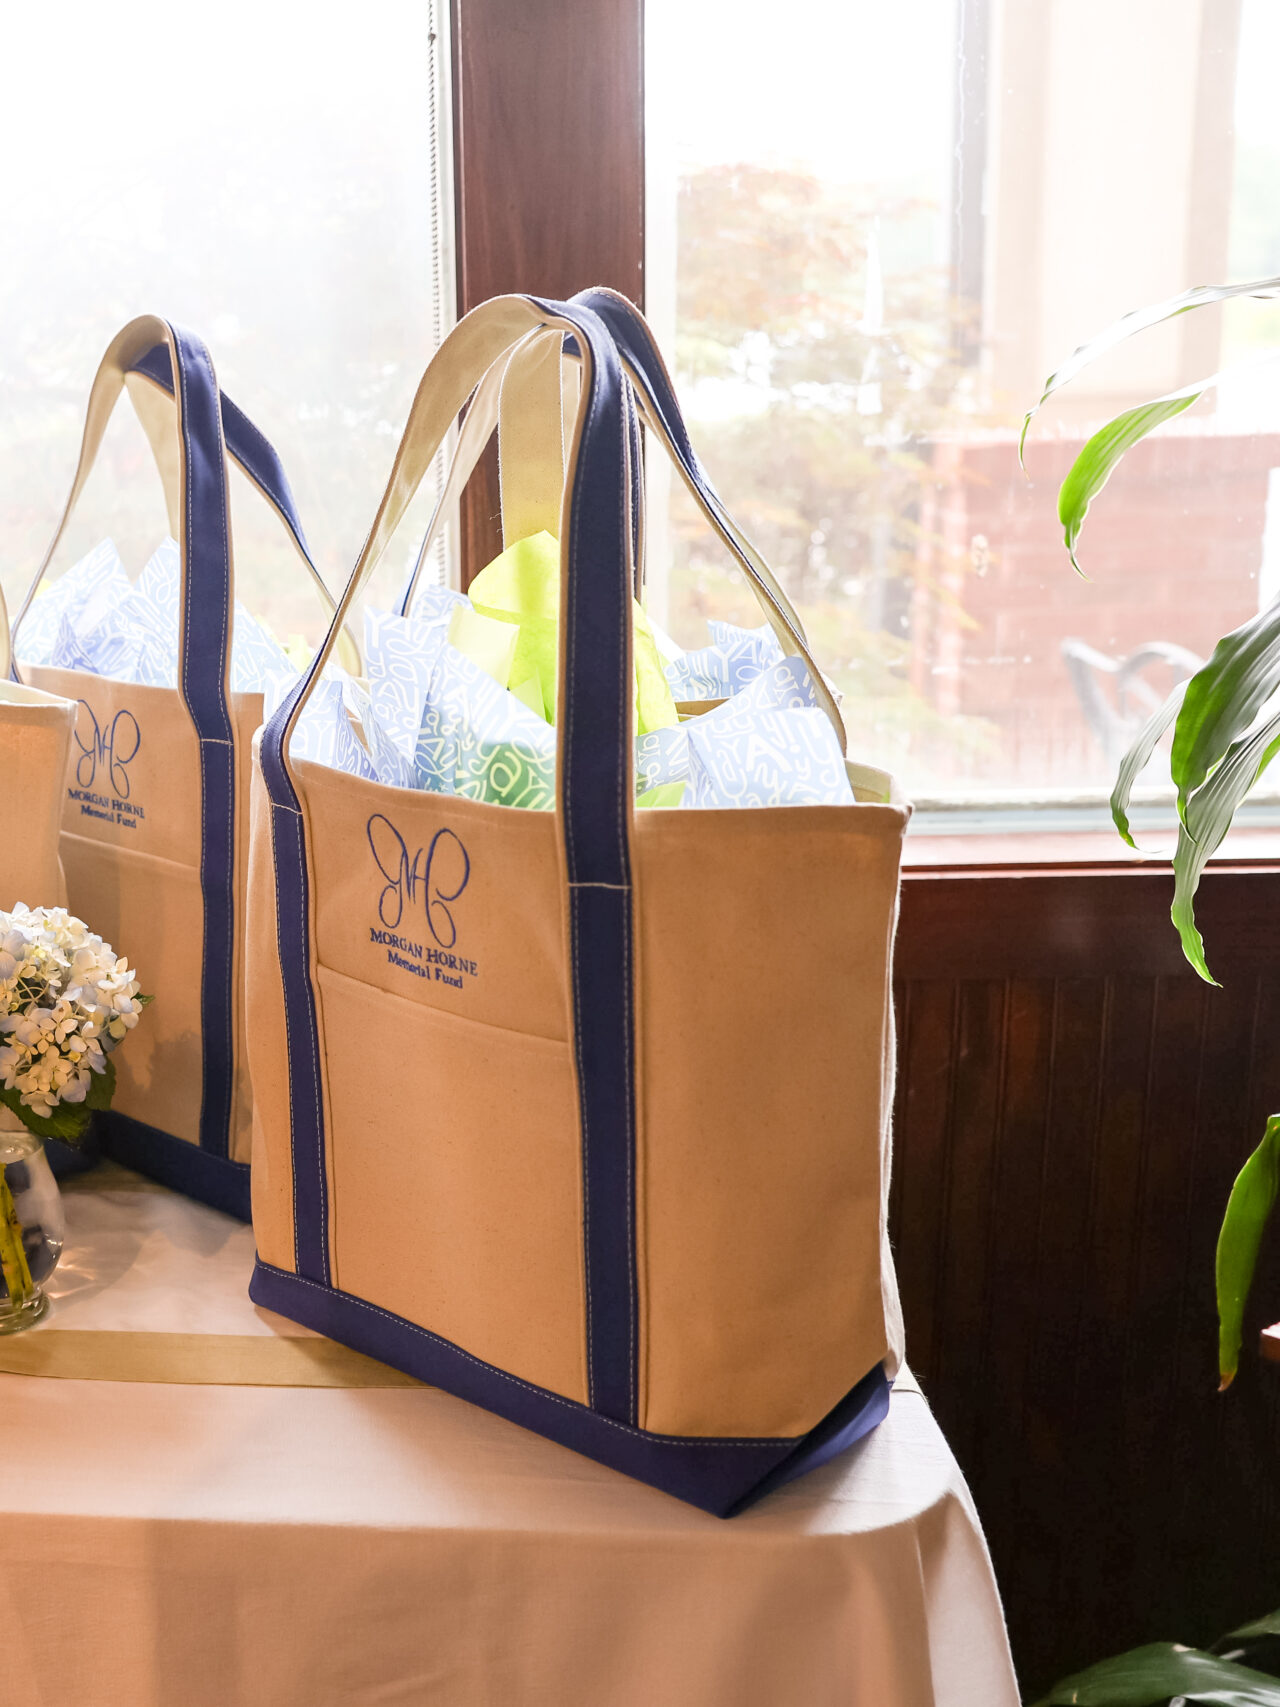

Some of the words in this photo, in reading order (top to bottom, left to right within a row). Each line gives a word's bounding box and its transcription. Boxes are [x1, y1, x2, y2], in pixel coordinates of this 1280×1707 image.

[68, 788, 109, 808] MORGAN
[112, 799, 145, 819] HORNE
[81, 805, 114, 822] Memorial
[117, 813, 137, 829] Fund
[370, 928, 422, 959] MORGAN
[426, 948, 478, 977] HORNE
[387, 949, 431, 981] Memorial
[435, 968, 463, 989] Fund
